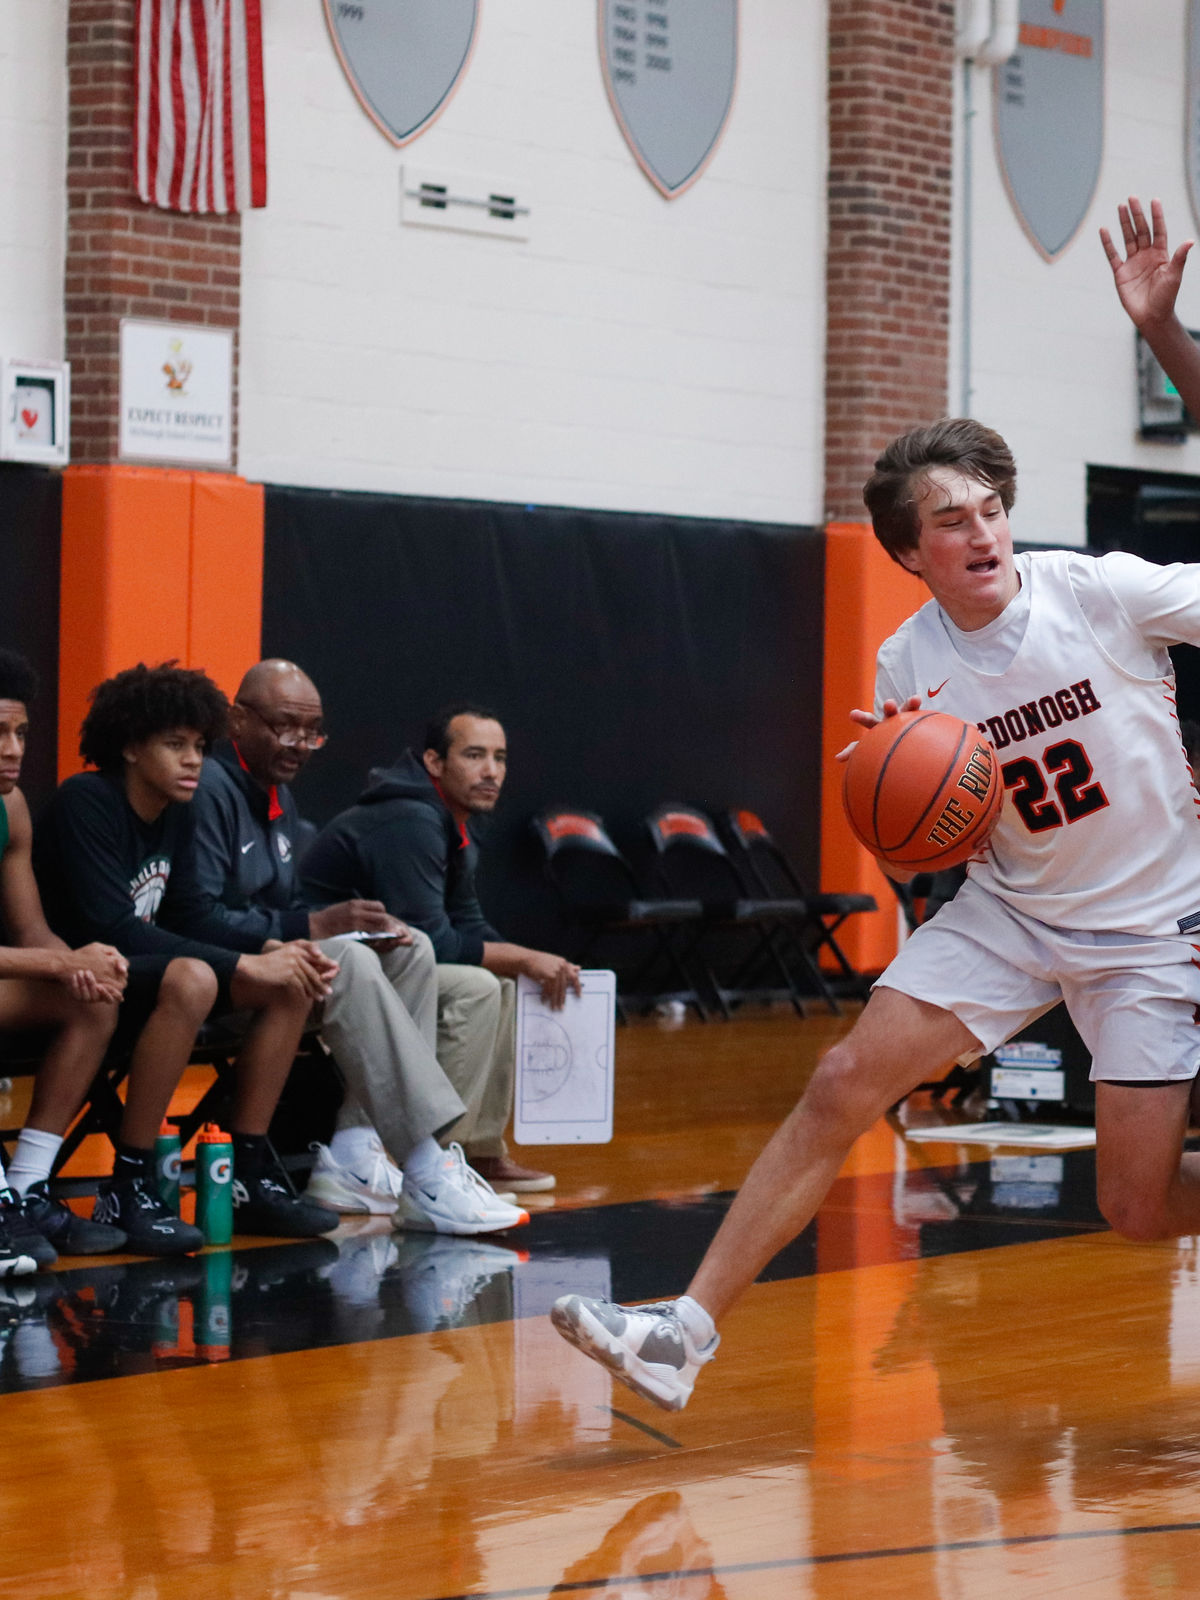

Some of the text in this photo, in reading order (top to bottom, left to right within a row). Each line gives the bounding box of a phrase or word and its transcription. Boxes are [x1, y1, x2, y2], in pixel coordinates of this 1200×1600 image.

[926, 743, 994, 847] THE ROCK
[1000, 738, 1111, 834] 22
[210, 1158, 231, 1185] G
